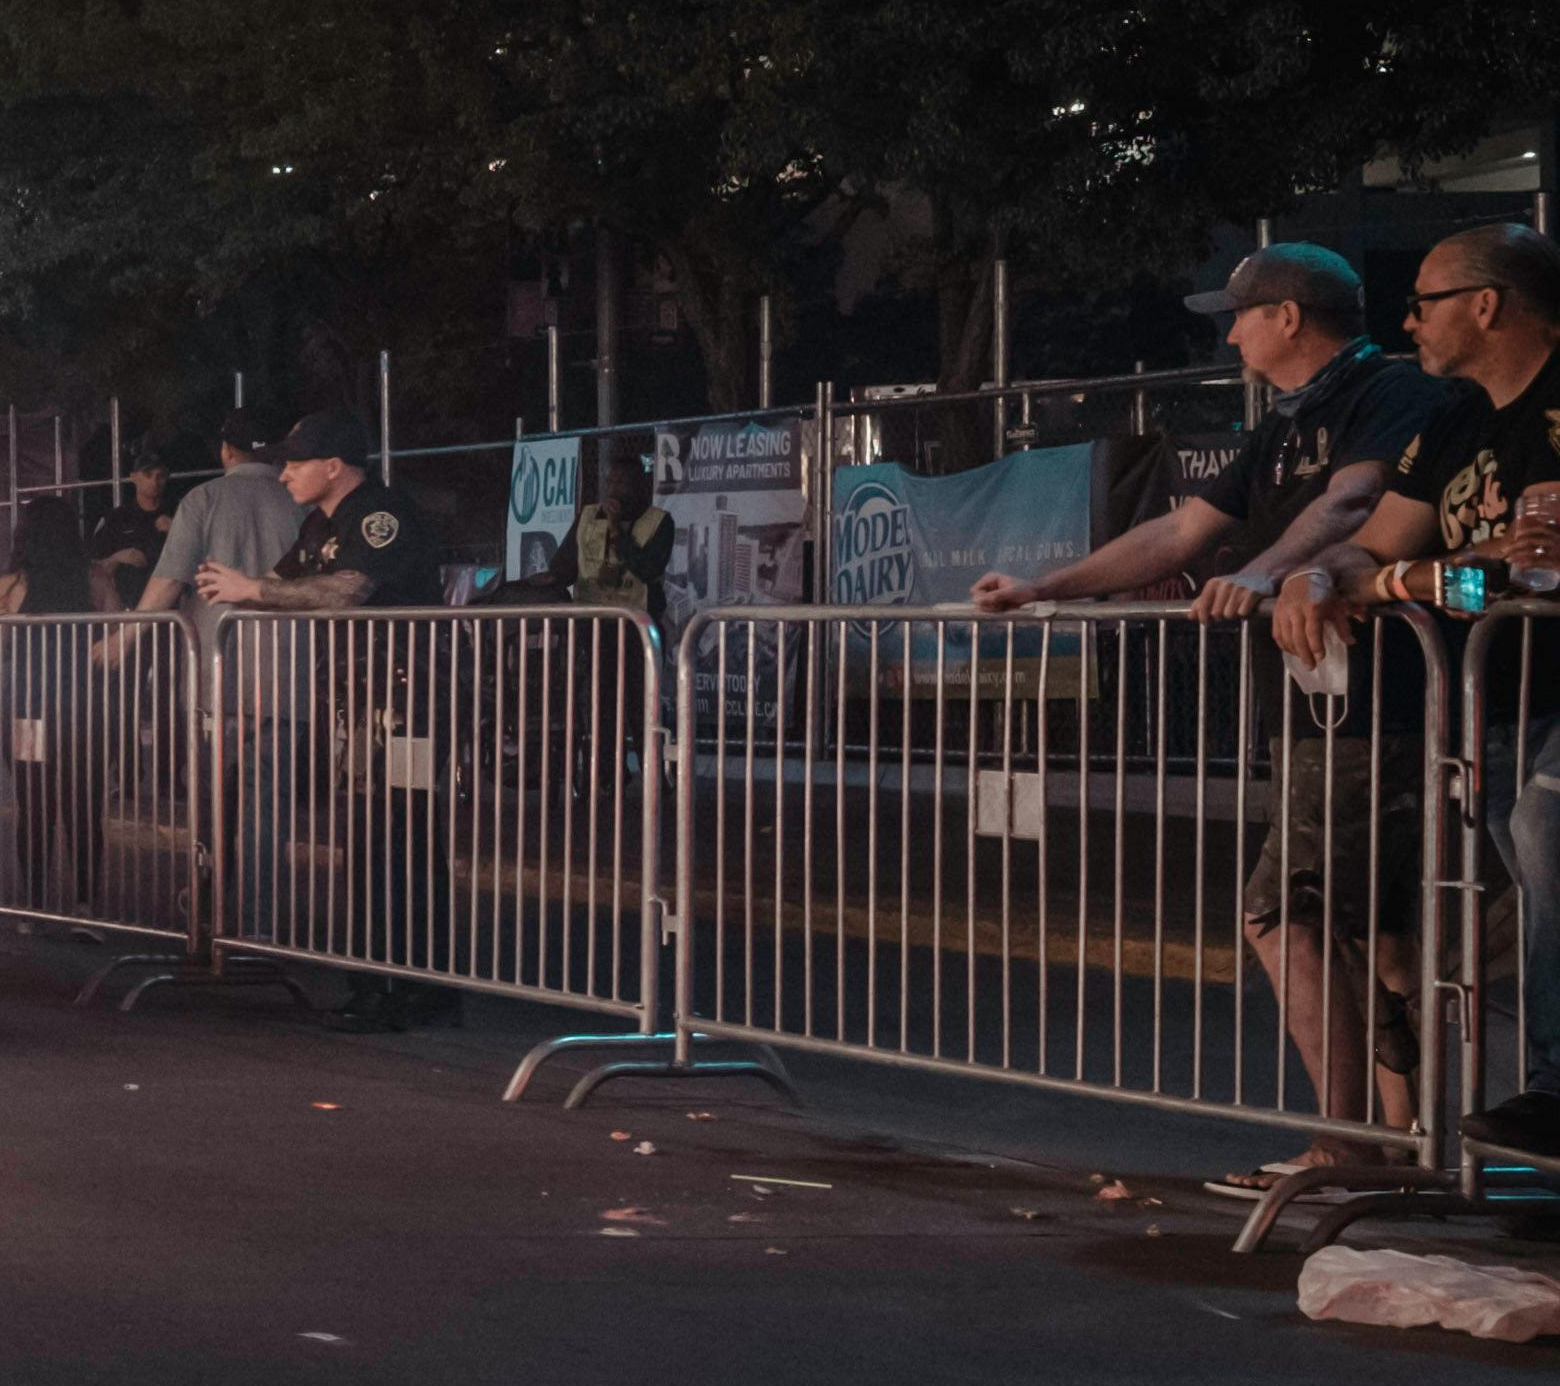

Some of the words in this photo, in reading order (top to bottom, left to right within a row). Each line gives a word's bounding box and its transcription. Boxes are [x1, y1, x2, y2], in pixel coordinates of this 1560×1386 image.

[689, 433, 723, 461] NOW
[725, 430, 791, 459] LEASING
[688, 464, 723, 482] LUXURY
[725, 462, 791, 480] APARTMENTS
[1177, 449, 1241, 479] THAN
[836, 551, 912, 604] DAIRY
[726, 674, 761, 694] TODY
